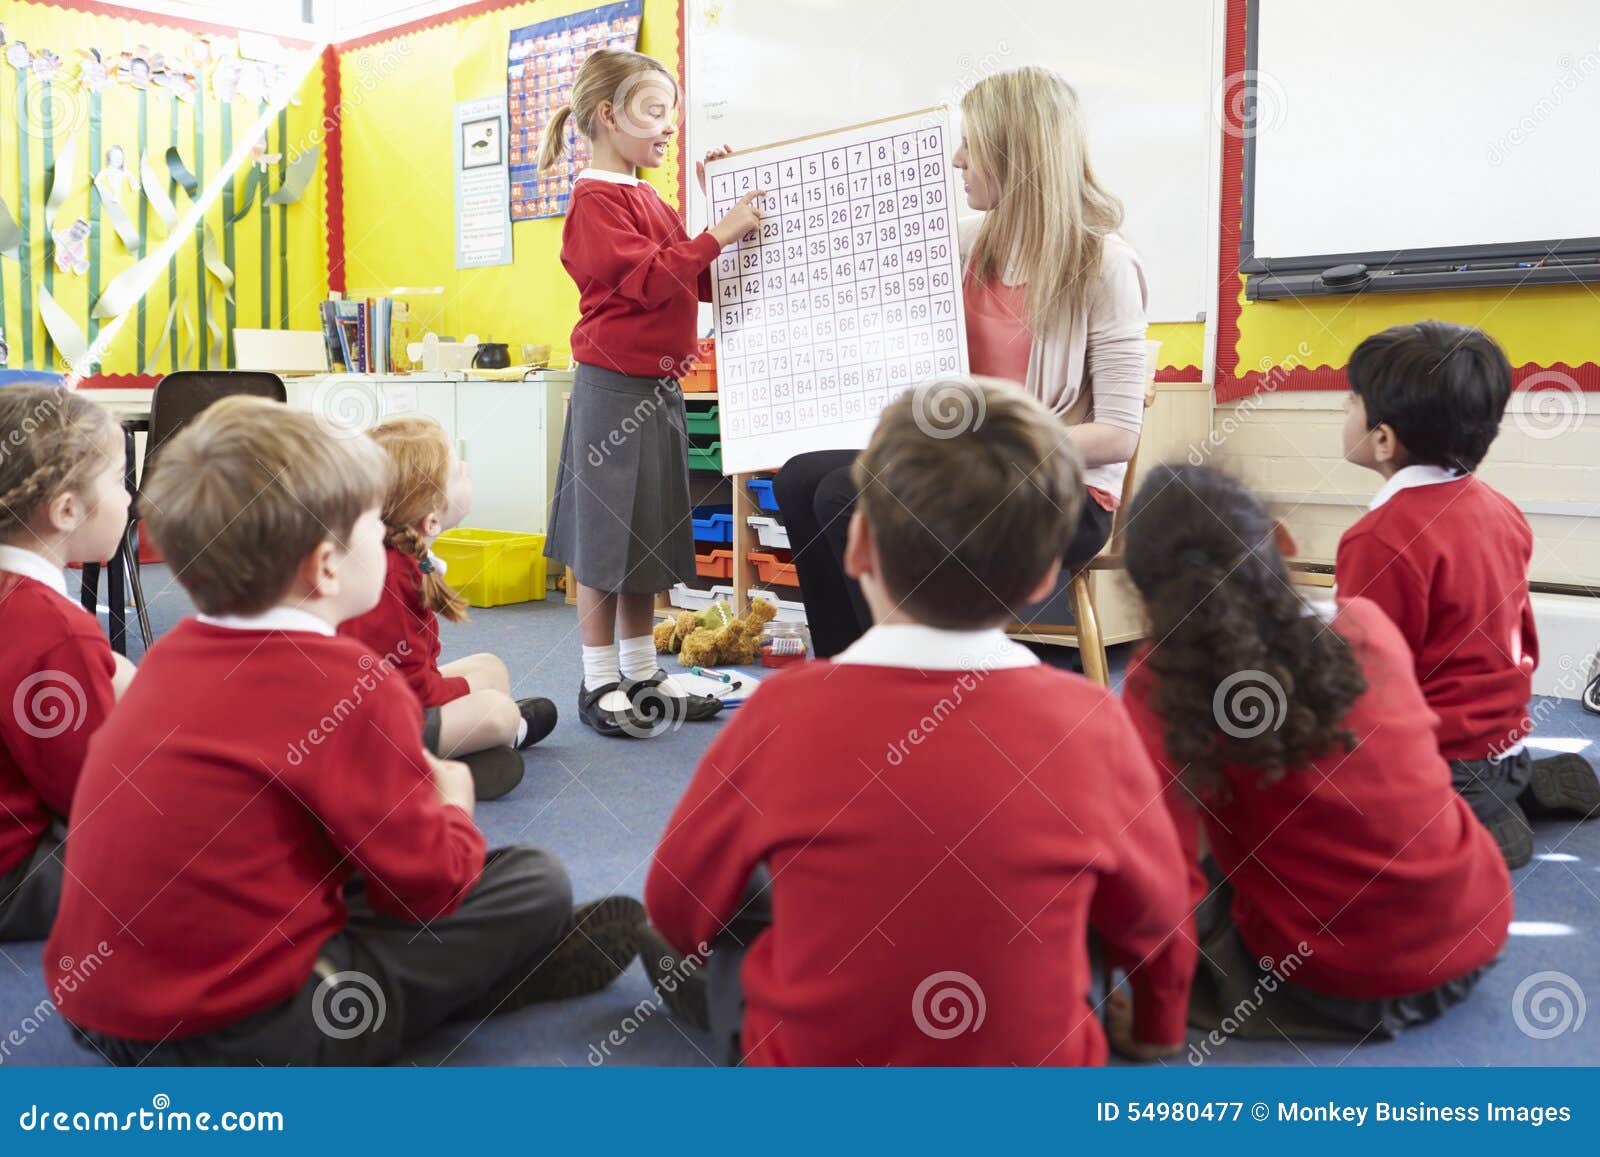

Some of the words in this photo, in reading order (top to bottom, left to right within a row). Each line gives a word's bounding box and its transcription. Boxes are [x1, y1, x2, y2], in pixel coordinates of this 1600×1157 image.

[721, 181, 727, 193] 1
[742, 176, 750, 190] 2
[764, 171, 772, 185] 3
[786, 166, 794, 179] 4
[809, 161, 817, 175] 5
[831, 156, 840, 170] 6
[854, 151, 862, 165] 7
[878, 146, 886, 160] 8
[902, 141, 910, 155] 9
[922, 135, 938, 150] 10
[761, 196, 776, 212] 13
[784, 192, 798, 207] 14
[807, 187, 822, 202] 15
[830, 182, 845, 197] 16
[853, 177, 868, 192] 17
[876, 172, 892, 188] 18
[900, 167, 915, 182] 19
[923, 162, 940, 178] 20
[763, 223, 779, 239] 23
[786, 218, 801, 234] 24
[808, 213, 824, 229] 25
[831, 208, 847, 224] 26
[854, 203, 870, 220] 27
[878, 199, 894, 215] 28
[902, 194, 918, 210] 29
[926, 189, 943, 205] 30
[722, 258, 736, 273] 31
[743, 253, 758, 269] 32
[765, 249, 781, 265] 33
[787, 245, 803, 260] 34
[810, 240, 826, 256] 35
[833, 235, 849, 251] 36
[856, 230, 873, 247] 37
[880, 226, 897, 242] 38
[904, 221, 920, 237] 39
[928, 216, 945, 232] 40
[724, 284, 737, 298] 41
[745, 279, 760, 295] 42
[767, 275, 783, 290] 43
[789, 271, 805, 286] 44
[812, 267, 828, 281] 45
[835, 262, 851, 277] 46
[859, 257, 874, 273] 47
[882, 253, 899, 268] 48
[906, 249, 923, 264] 49
[930, 244, 947, 260] 50
[725, 311, 739, 326] 51
[746, 306, 762, 321] 52
[769, 302, 785, 317] 53
[791, 298, 807, 313] 54
[814, 293, 830, 309] 55
[837, 289, 853, 305] 56
[861, 285, 877, 301] 57
[884, 280, 901, 297] 58
[908, 276, 925, 292] 59
[932, 271, 949, 288] 60
[727, 335, 741, 352] 61
[770, 328, 786, 344] 63
[792, 325, 809, 341] 64
[816, 320, 832, 336] 65
[839, 316, 855, 332] 66
[862, 312, 879, 328] 67
[886, 307, 903, 324] 68
[910, 303, 927, 320] 69
[934, 299, 951, 315] 70
[728, 362, 742, 379] 71
[750, 359, 766, 375] 72
[772, 355, 788, 371] 73
[795, 352, 811, 367] 74
[817, 348, 834, 363] 75
[840, 344, 857, 359] 76
[911, 331, 929, 347] 79
[937, 327, 954, 343] 80
[730, 390, 744, 405] 81
[751, 386, 768, 402] 82
[774, 382, 790, 398] 83
[796, 379, 812, 394] 84
[820, 375, 836, 391] 85
[843, 371, 860, 387] 86
[866, 367, 882, 383] 87
[890, 363, 907, 380] 88
[915, 359, 932, 376] 89
[939, 355, 956, 372] 90
[752, 413, 769, 429] 92
[775, 410, 792, 425] 93
[798, 407, 814, 422] 94
[821, 402, 839, 419] 95
[845, 399, 861, 414] 96
